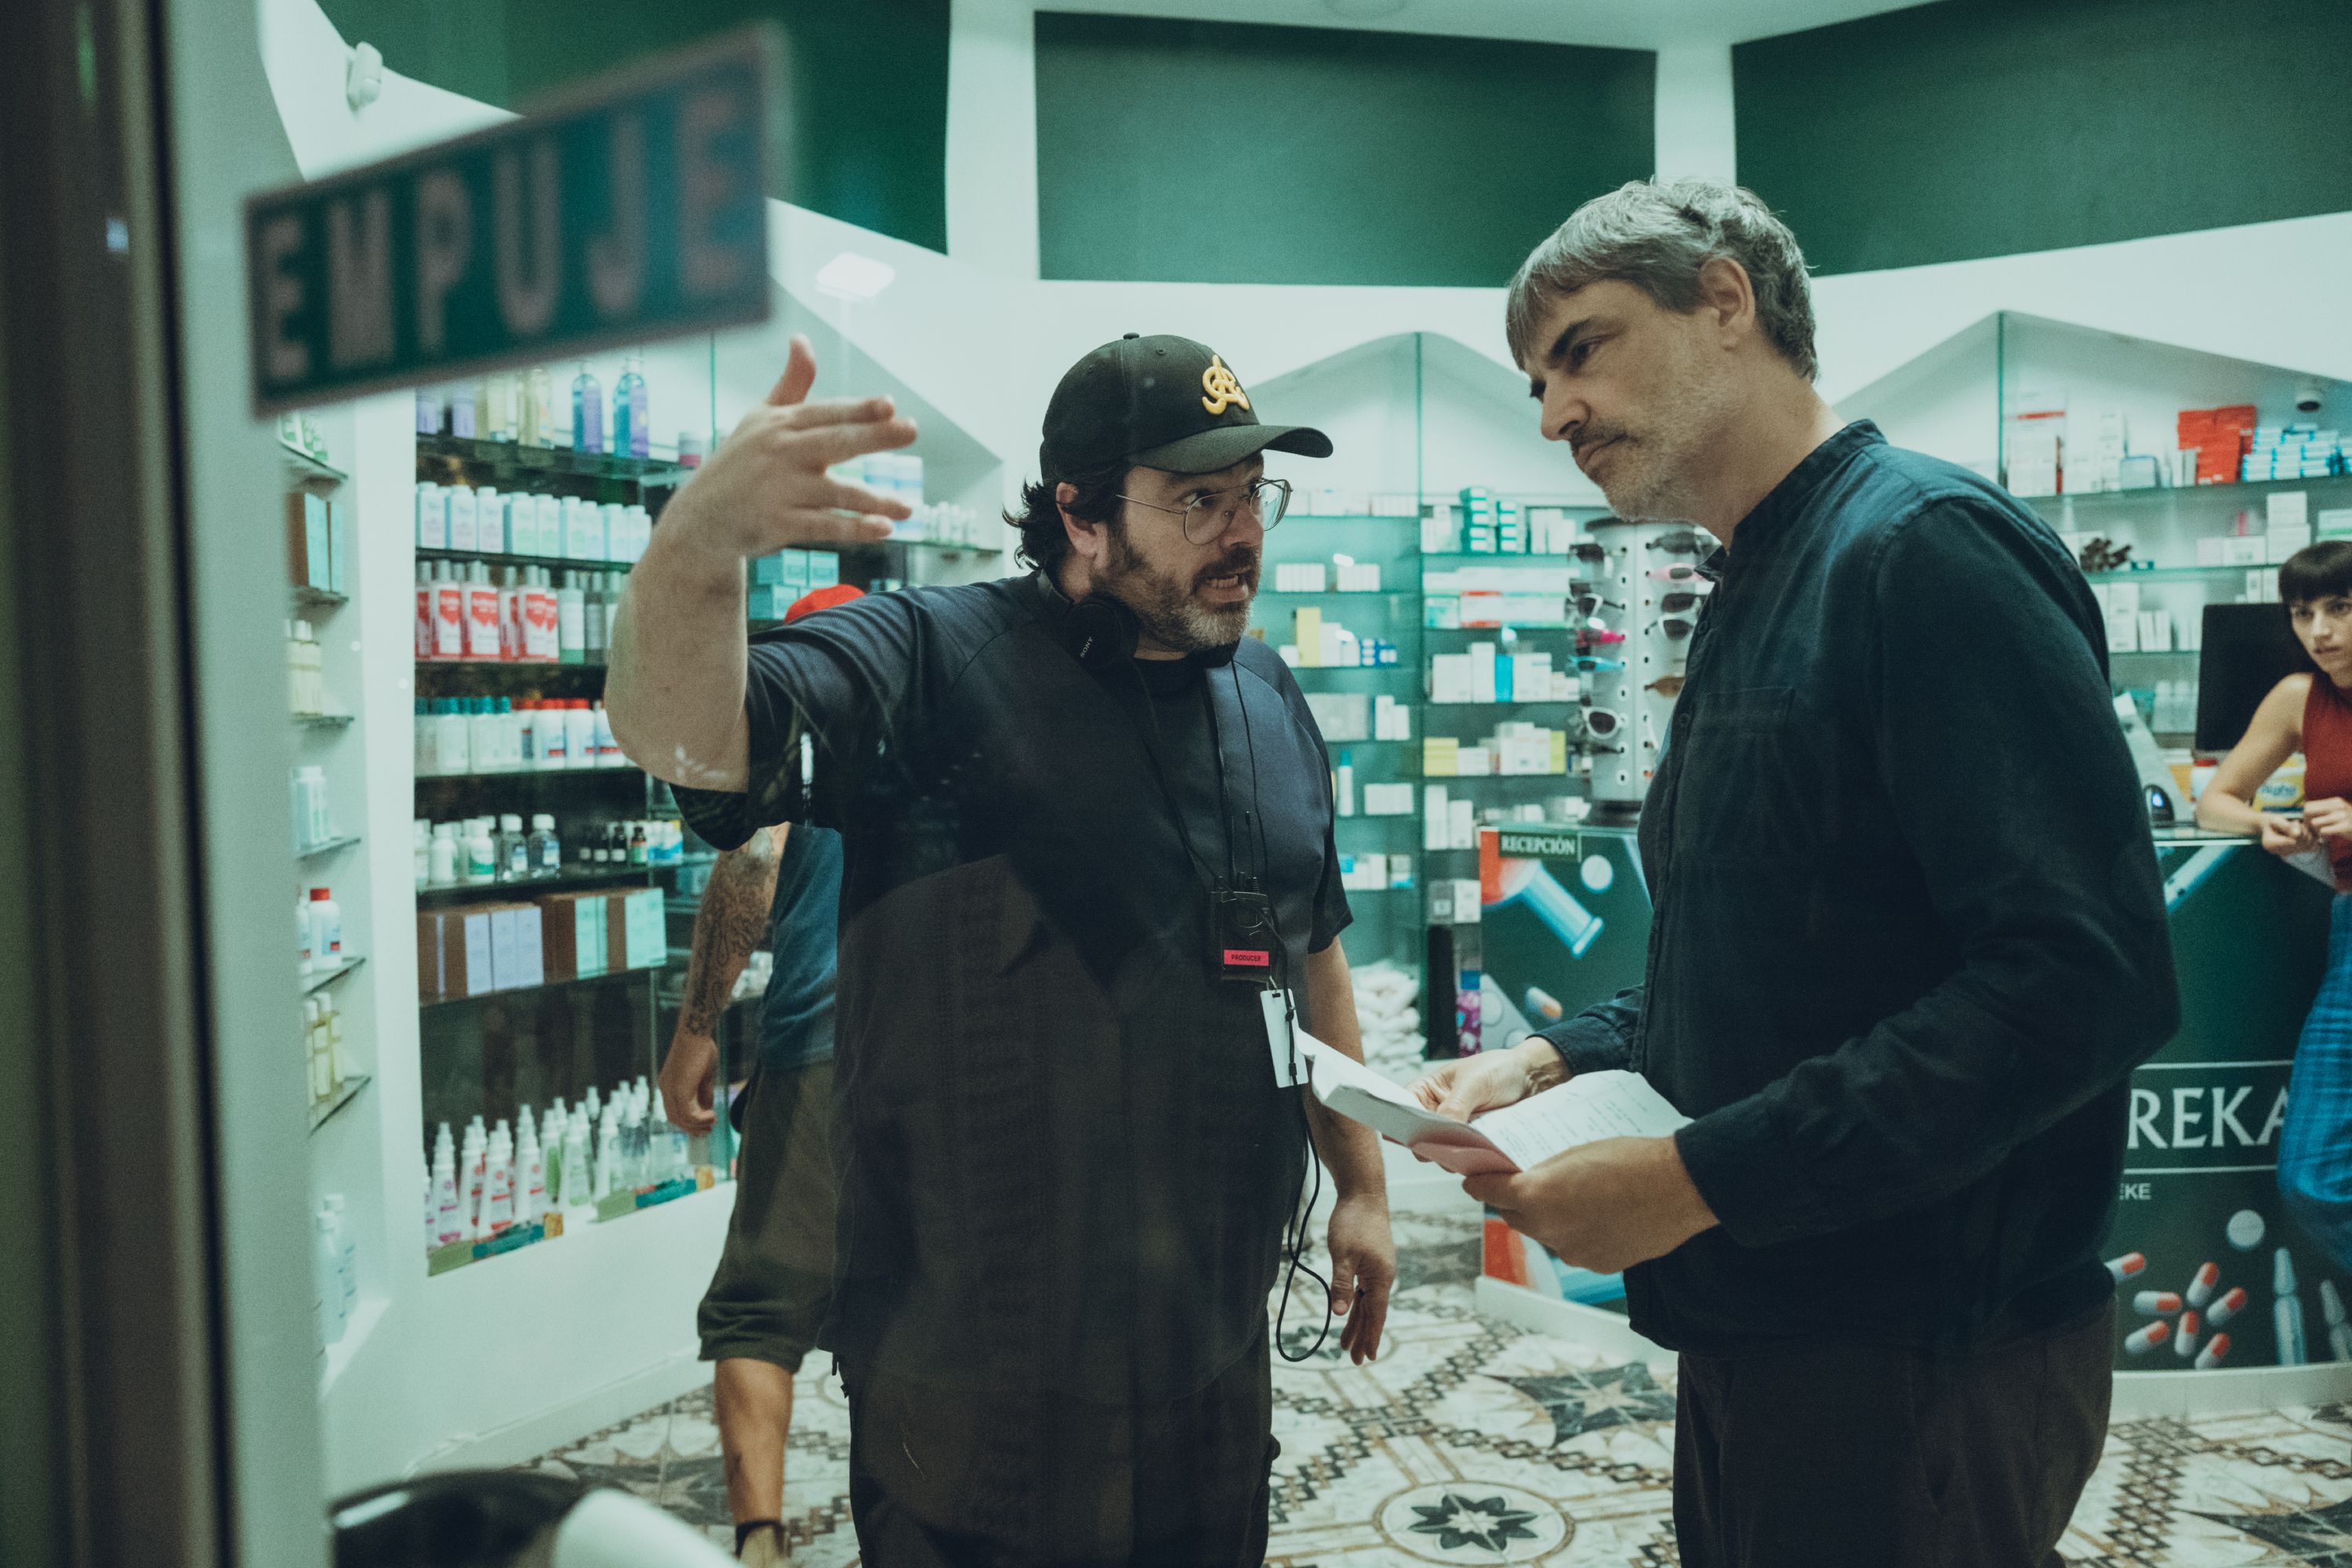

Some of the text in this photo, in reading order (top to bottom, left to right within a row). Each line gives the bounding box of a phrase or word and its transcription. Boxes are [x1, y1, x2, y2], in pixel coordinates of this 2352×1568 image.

[263, 90, 740, 381] EMPUJE
[1080, 636, 1093, 659] SONY
[1501, 834, 1576, 856] RECEPCIÓN
[1231, 953, 1261, 962] PRODUCER
